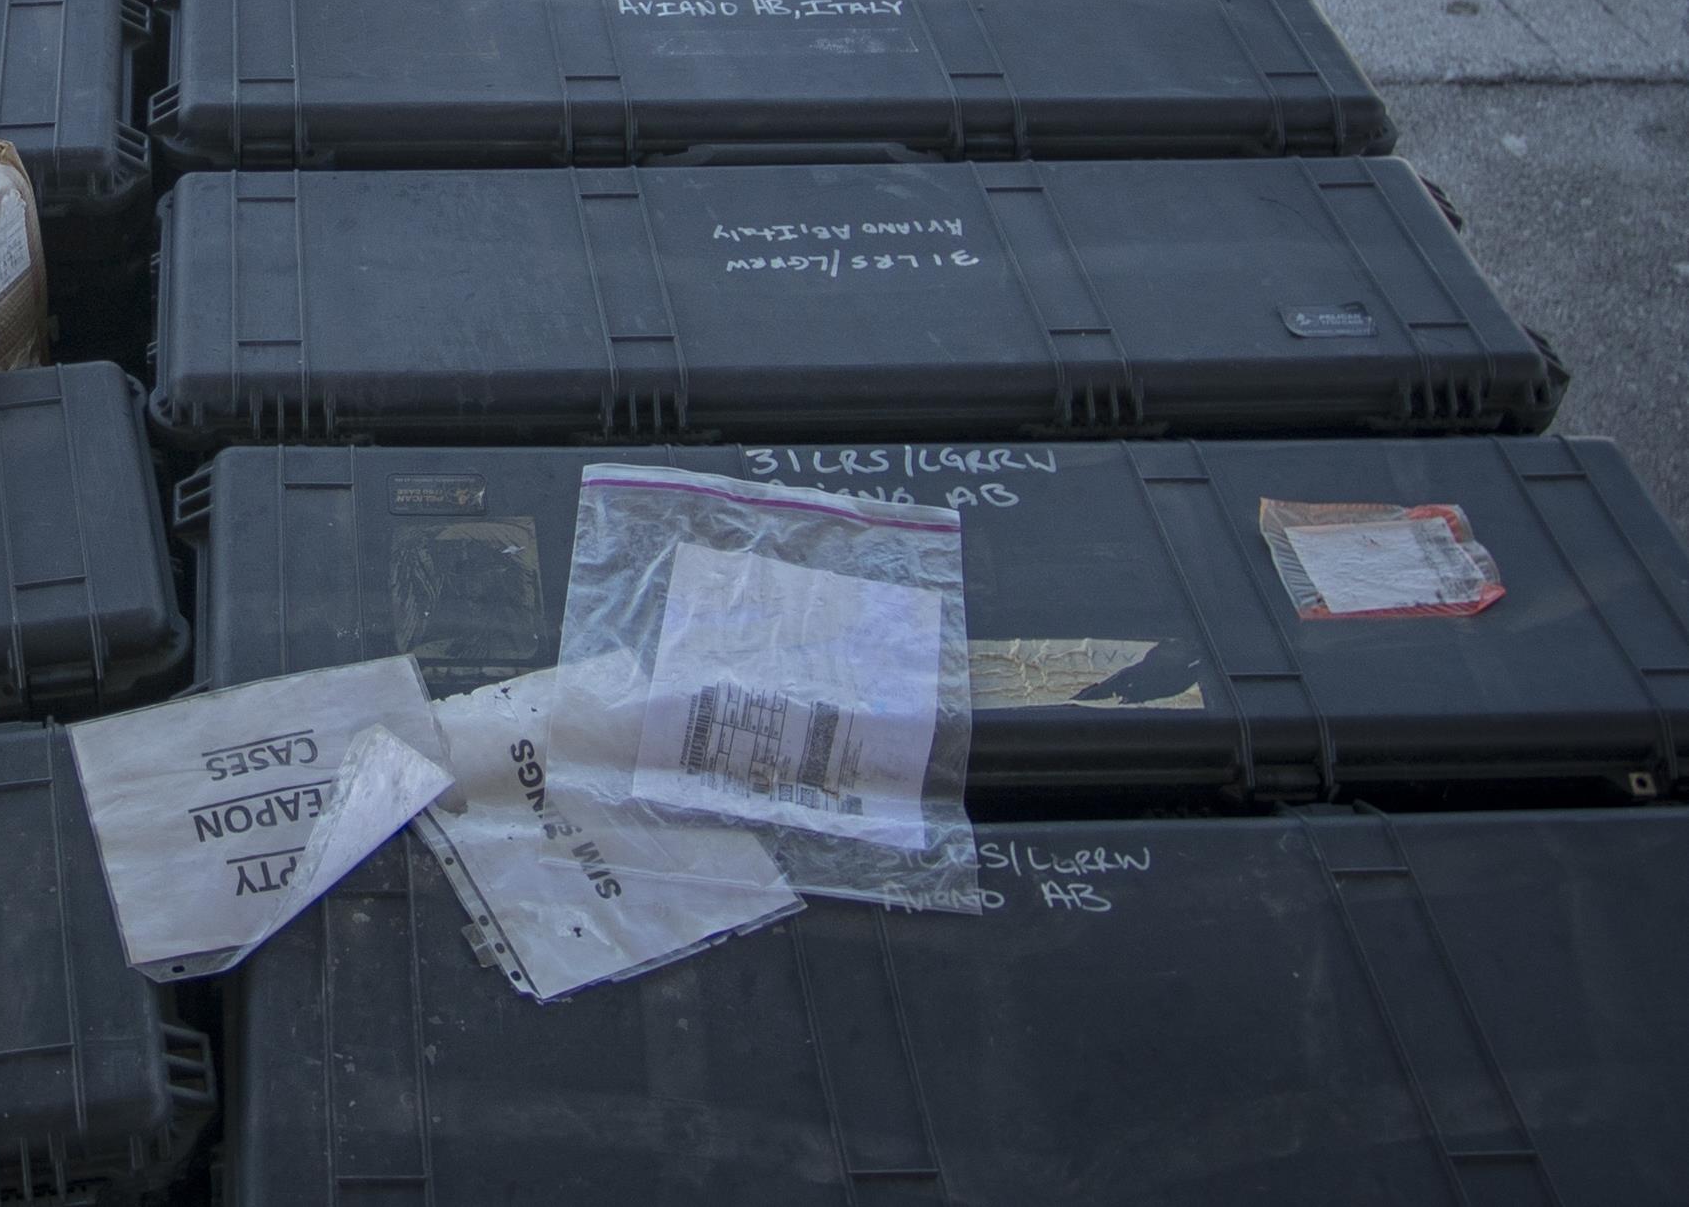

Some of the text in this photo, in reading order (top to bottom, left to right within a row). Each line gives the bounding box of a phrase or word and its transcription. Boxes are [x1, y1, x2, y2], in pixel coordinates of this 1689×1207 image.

[205, 736, 319, 781] CASES
[192, 788, 324, 843] EAPON
[1041, 881, 1112, 912] AB
